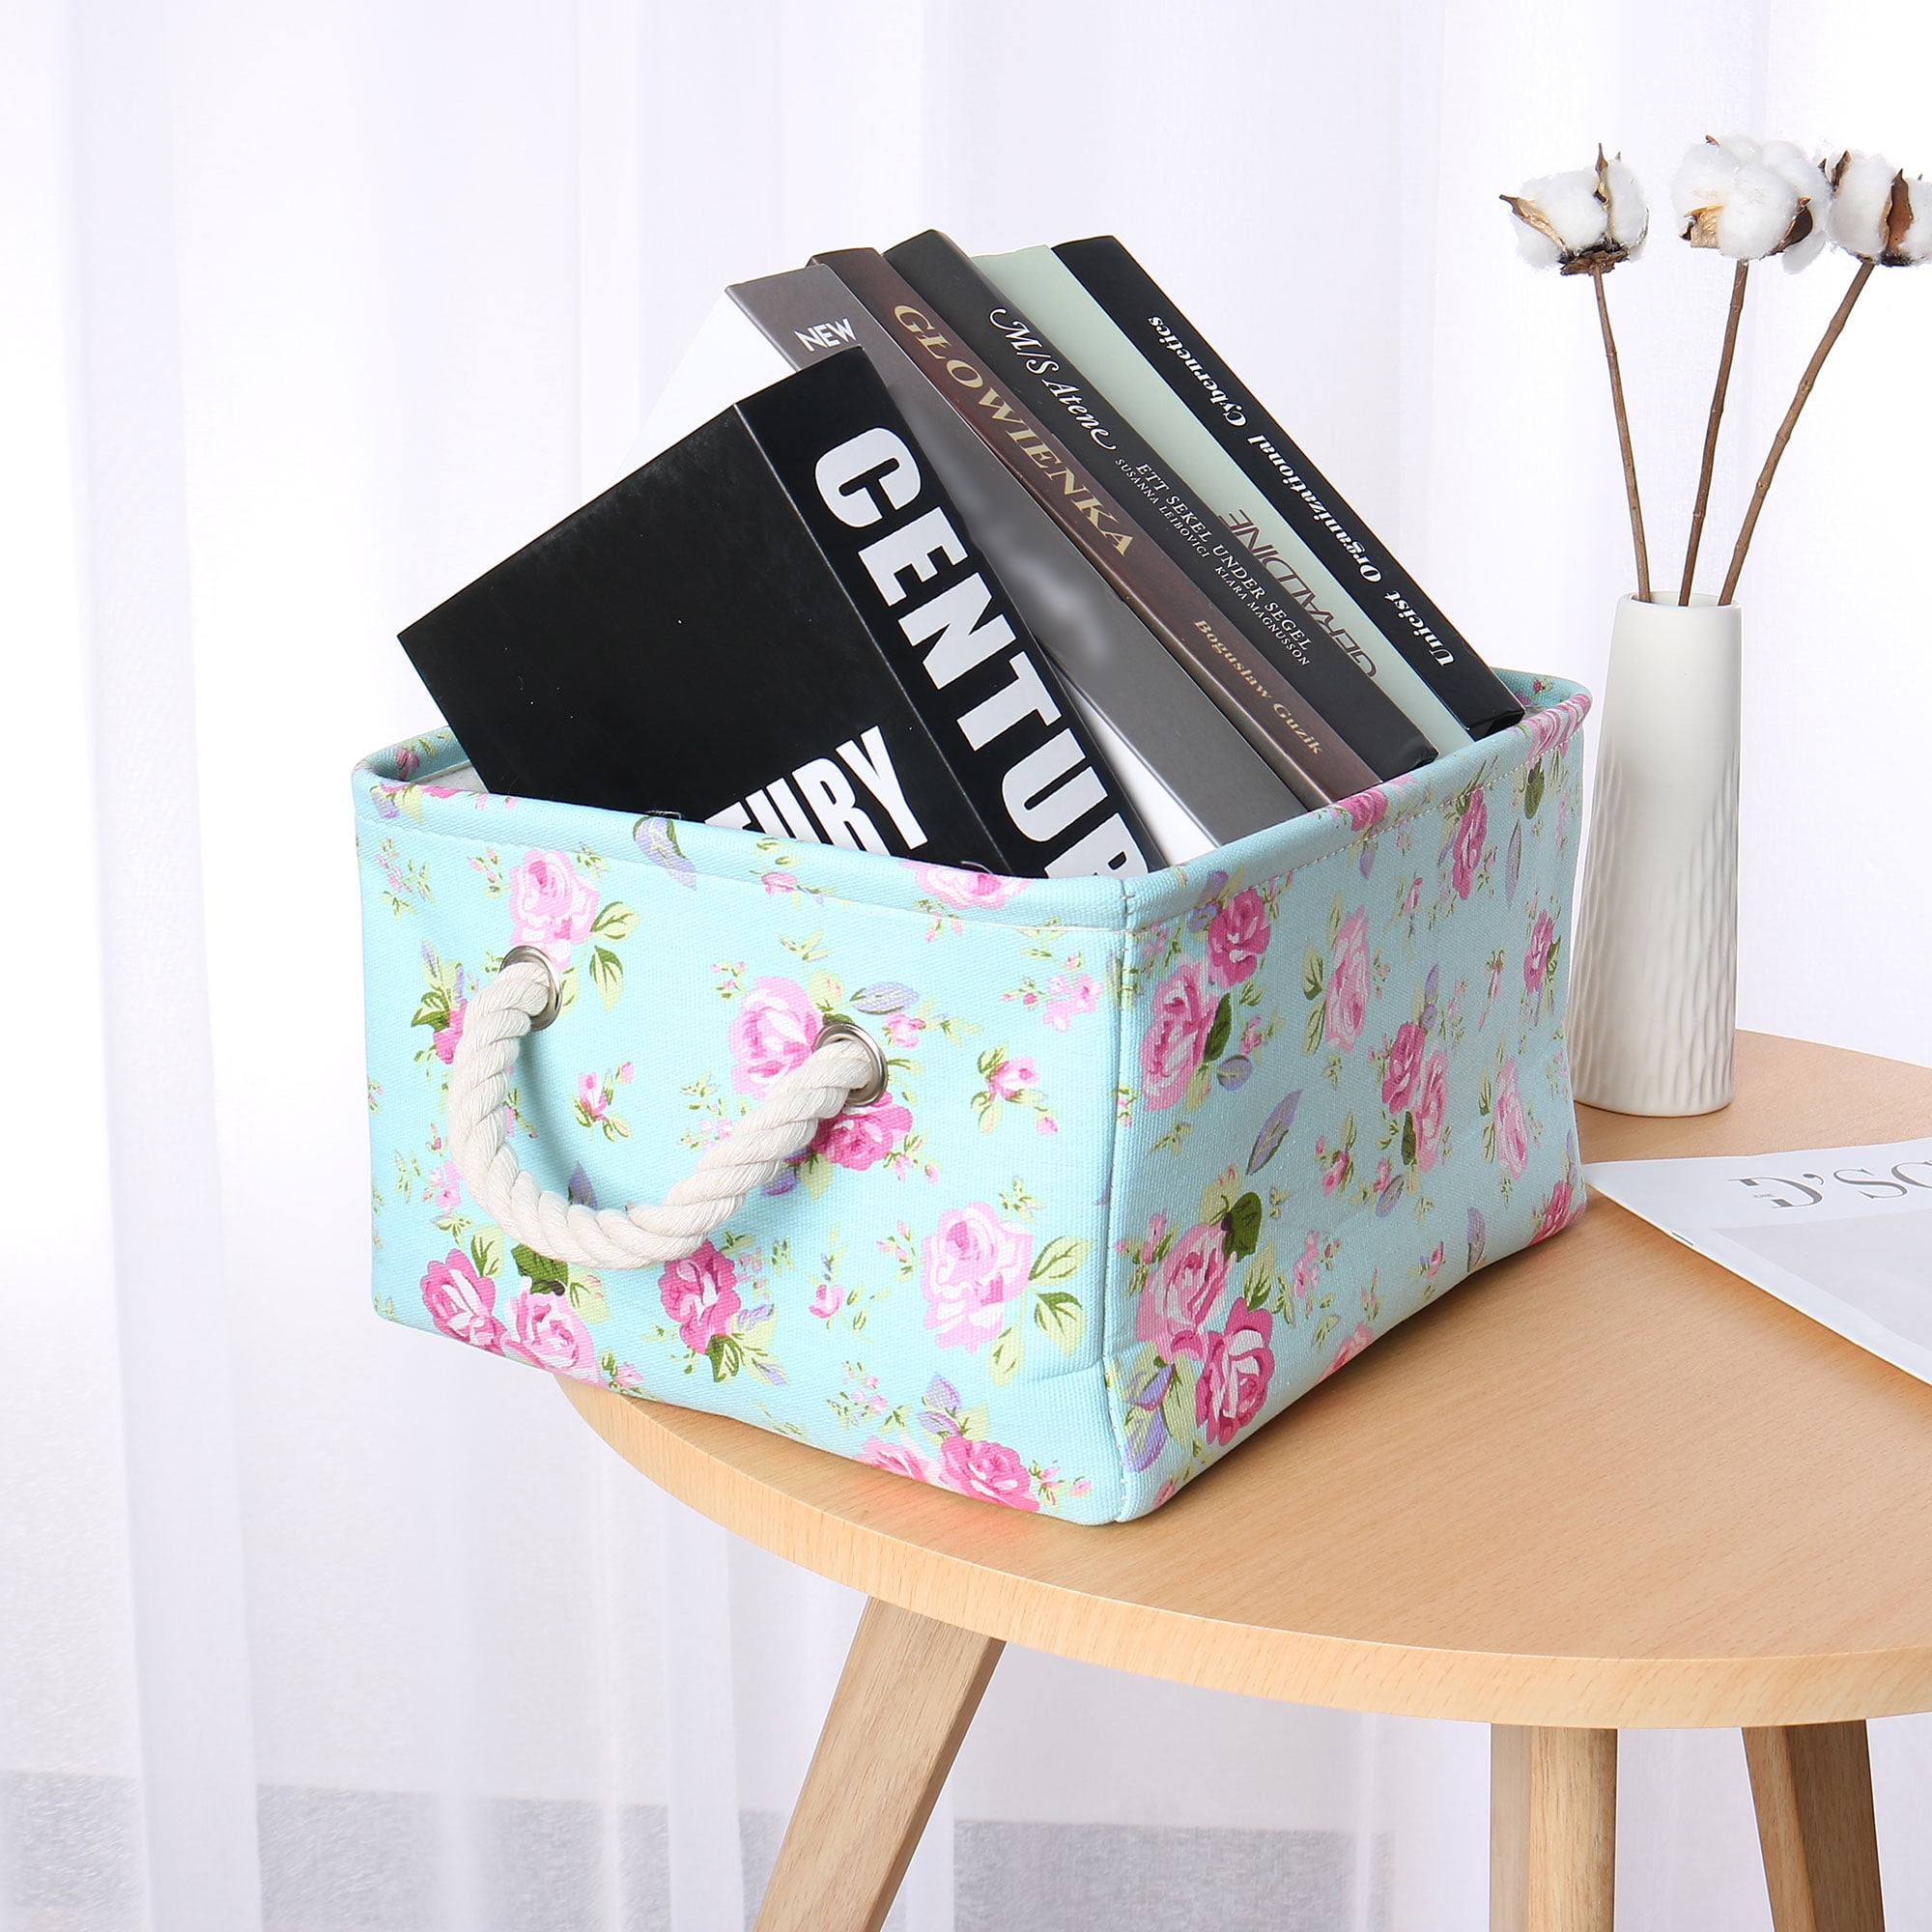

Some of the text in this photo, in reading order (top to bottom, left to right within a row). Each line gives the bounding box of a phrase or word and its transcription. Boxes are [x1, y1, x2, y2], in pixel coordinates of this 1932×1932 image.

[794, 318, 857, 353] NEW
[989, 308, 1117, 450] M/S Atene
[1115, 458, 1311, 667] SUSANNA LEIBOVICI KLARA MAGNUSSON
[1136, 464, 1314, 650] ETT SEKEL UNDER SEGEL
[1148, 317, 1455, 668] Unicist Organizational Cybernetics
[1273, 703, 1322, 754] Guzik
